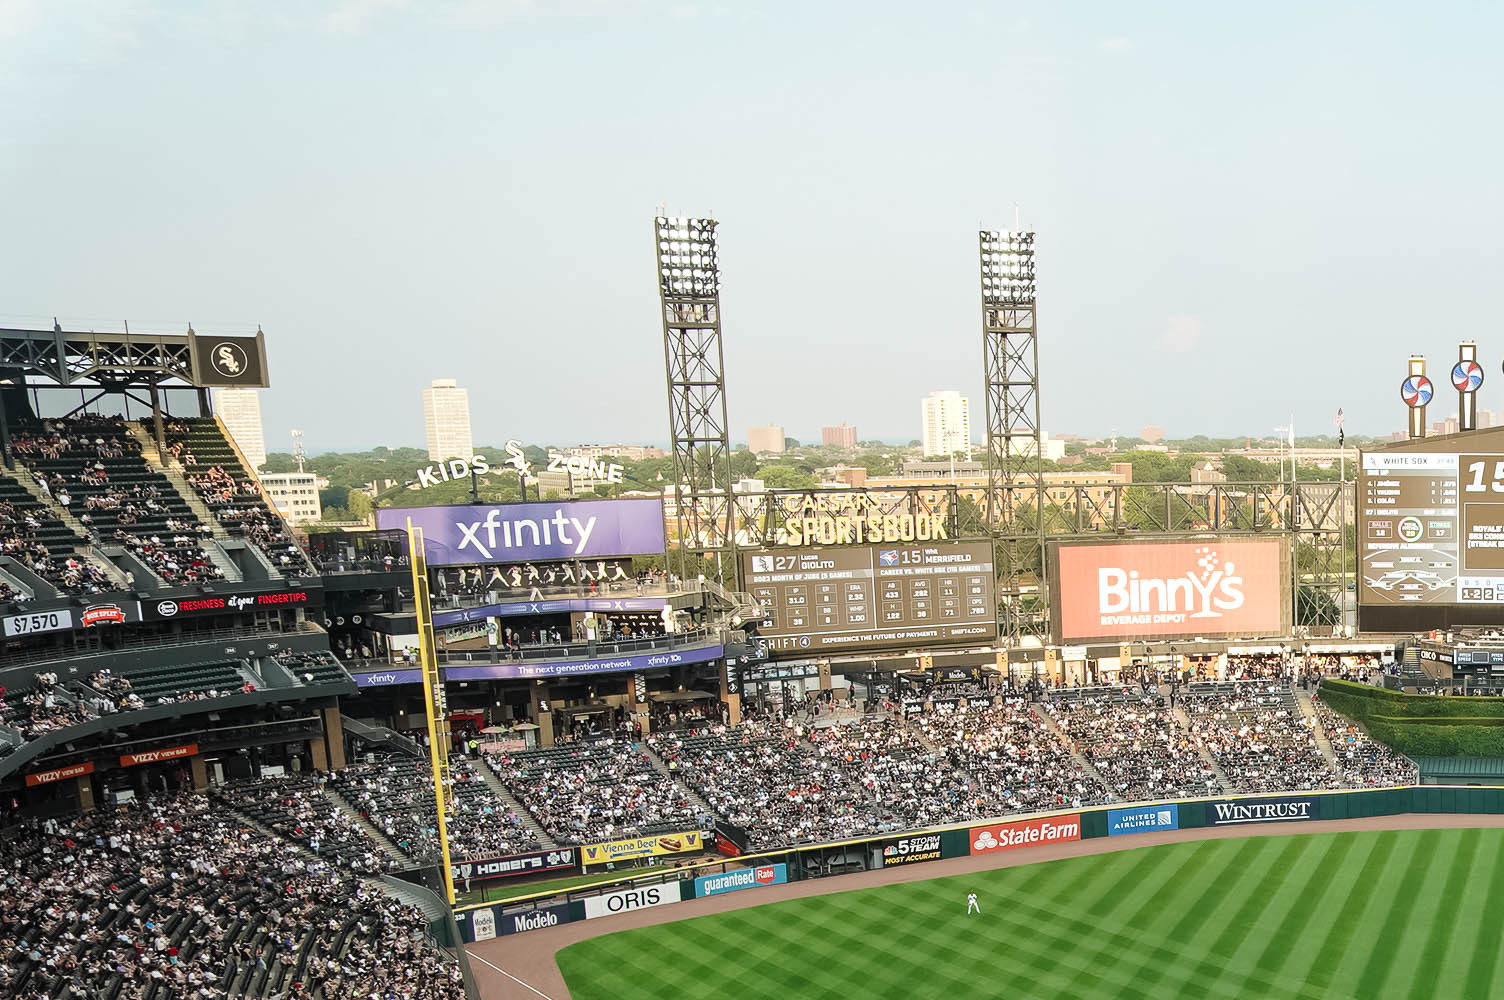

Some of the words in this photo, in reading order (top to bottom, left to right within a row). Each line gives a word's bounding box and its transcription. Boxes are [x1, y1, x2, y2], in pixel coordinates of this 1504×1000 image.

[416, 455, 490, 489] KIDS
[546, 452, 625, 484] ZONE
[785, 494, 881, 512] CAESARS
[456, 509, 597, 559] xfinity
[785, 513, 948, 547] SPORTSBOOK
[776, 556, 797, 570] 27
[901, 550, 921, 564] 15
[925, 554, 972, 563] MERRIFIELD
[801, 561, 835, 570] GIOLITO
[1464, 590, 1481, 598] 1-2
[179, 598, 225, 611] FRESHNESS
[257, 592, 307, 605] FINGERTIPS
[14, 613, 58, 633] $7,570
[1101, 614, 1151, 625] BEVERAGE
[1153, 614, 1186, 624] DEPOT
[873, 632, 896, 640] FUTURE
[518, 666, 533, 674] The
[535, 665, 554, 673] next
[556, 661, 600, 674] generation
[601, 659, 632, 669] network
[648, 656, 669, 666] xfinity
[367, 673, 396, 685] xfinity
[131, 751, 160, 763] VIZZY
[36, 770, 61, 783] VIZZY
[1122, 813, 1156, 822] UNITED
[1214, 802, 1312, 820] WINTRUST
[1114, 819, 1156, 829] AIRLINES
[602, 841, 635, 853] Vienna
[637, 838, 657, 850] Beef
[898, 840, 910, 854] 5
[910, 835, 941, 847] STORM
[909, 841, 940, 852] TEAM
[885, 856, 904, 865] MOST
[904, 851, 941, 863] ACCURATE
[704, 869, 755, 896] guaranteed
[756, 869, 774, 881] Rate
[607, 888, 660, 912] ORIS
[514, 912, 558, 933] Modelo
